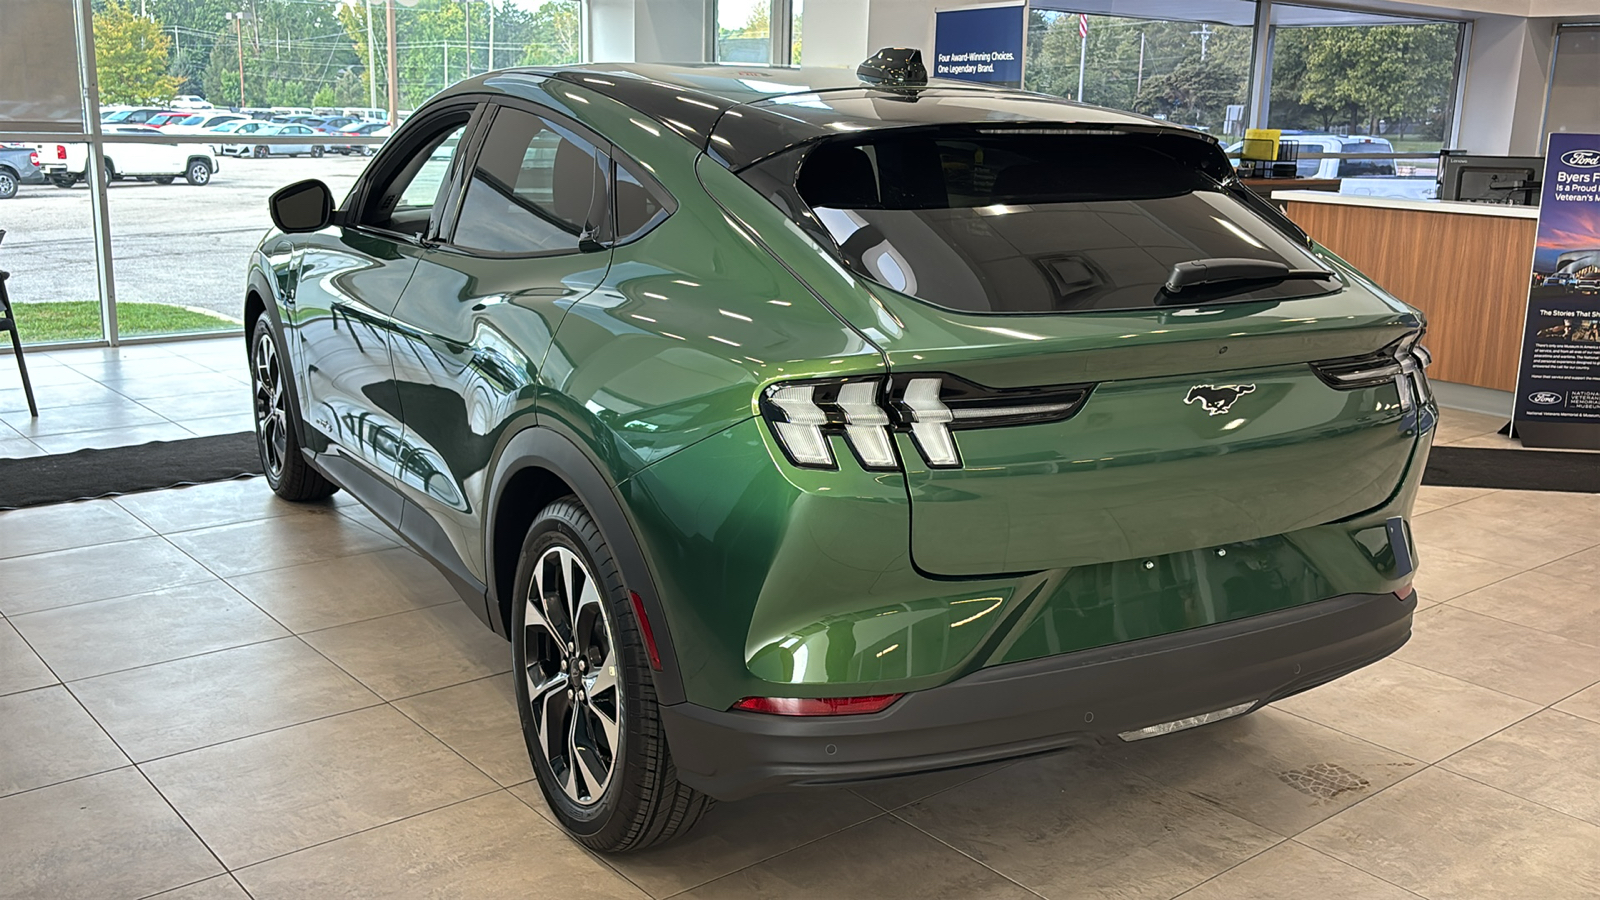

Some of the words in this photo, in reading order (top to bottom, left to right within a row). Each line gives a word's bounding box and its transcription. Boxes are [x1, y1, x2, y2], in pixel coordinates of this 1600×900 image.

[938, 54, 950, 62] Four
[951, 52, 990, 62] Award-Winning
[992, 52, 1014, 60] Choices.
[938, 65, 948, 73] One
[950, 64, 976, 74] Legendary
[978, 64, 994, 72] Brand.
[1558, 172, 1590, 184] Byers
[1572, 184, 1597, 192] Proud
[1555, 193, 1593, 202] Veteran's
